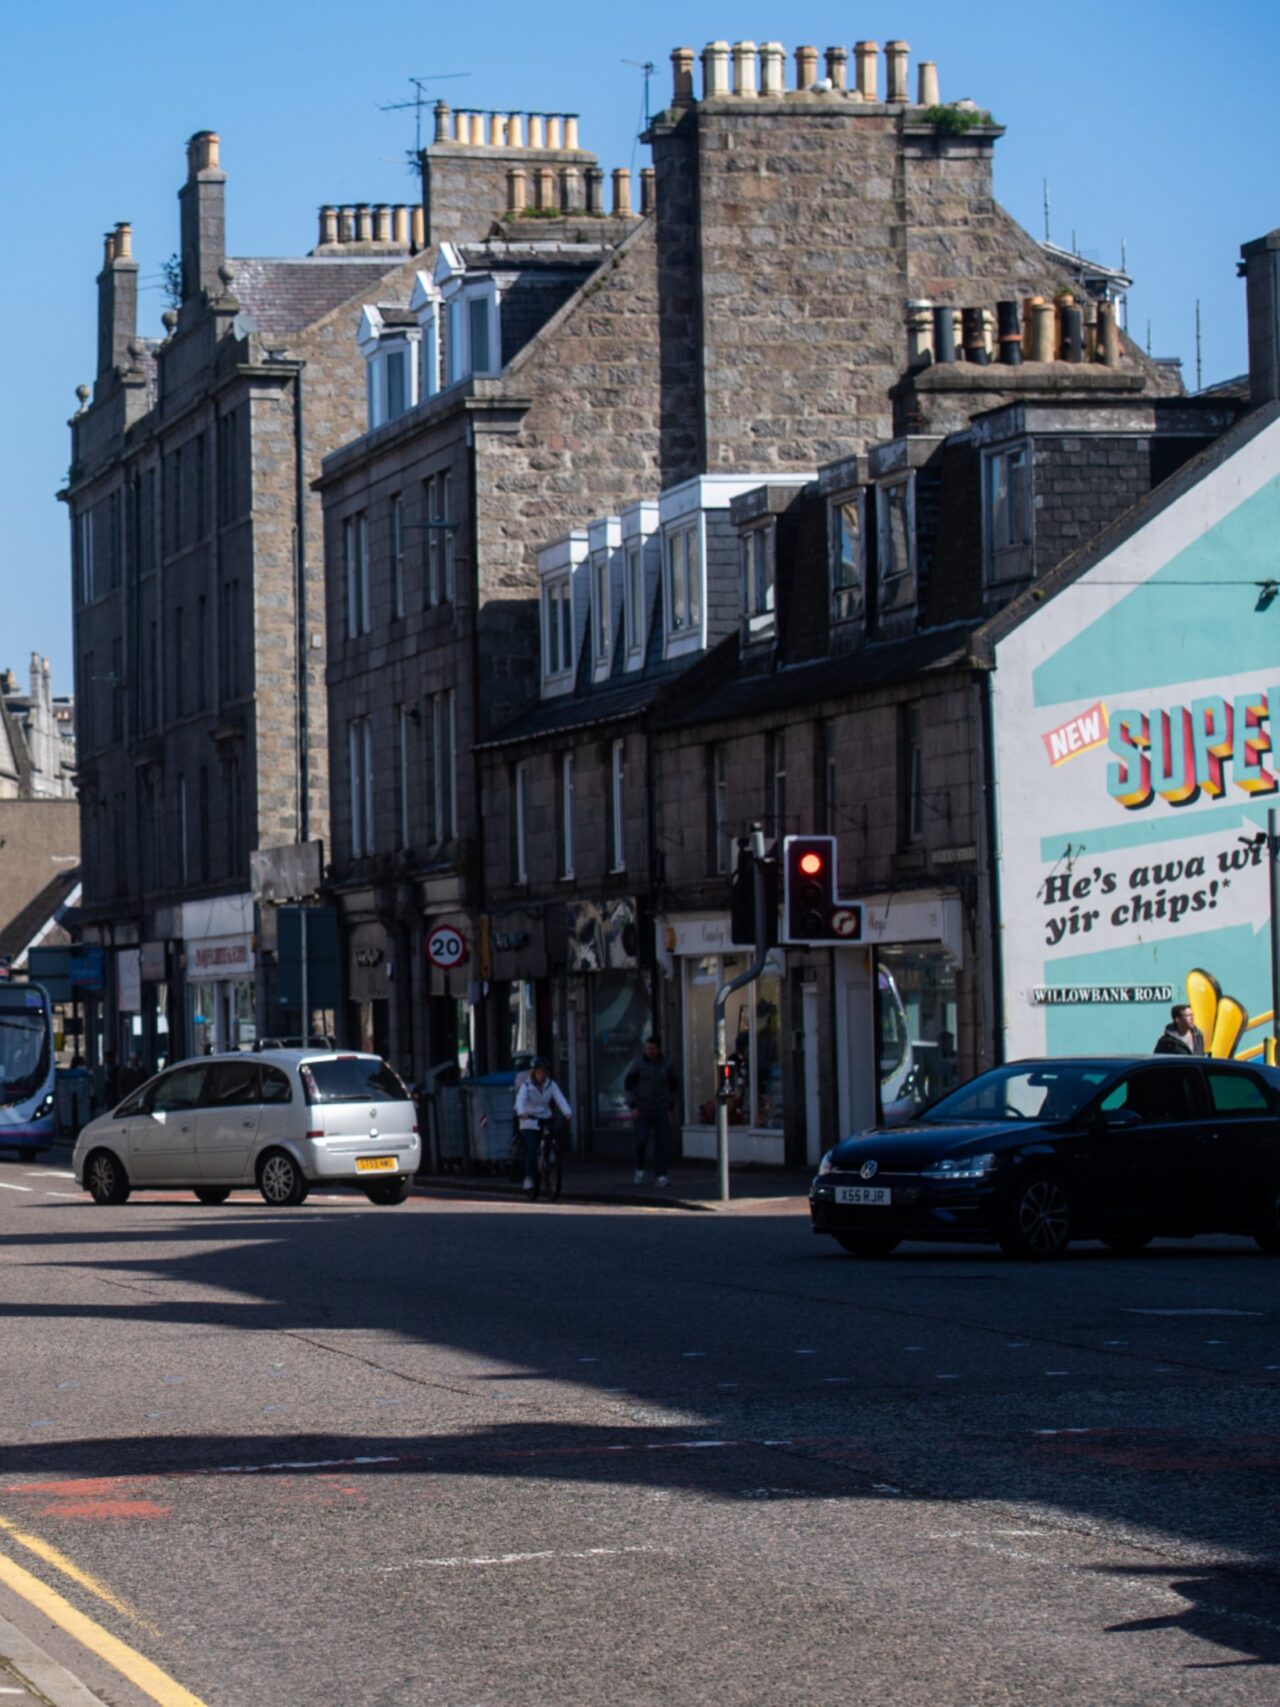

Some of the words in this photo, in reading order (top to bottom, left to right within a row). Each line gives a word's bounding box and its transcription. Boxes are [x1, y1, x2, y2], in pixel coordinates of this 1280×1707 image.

[1050, 711, 1100, 761] NEW
[1107, 686, 1280, 811] SUPE
[1043, 867, 1117, 905] He's
[1129, 856, 1205, 889] awa
[432, 938, 461, 956] 20
[1045, 905, 1100, 946] yir
[1035, 987, 1130, 1002] WILLOWBANK
[1135, 986, 1172, 1000] ROAD
